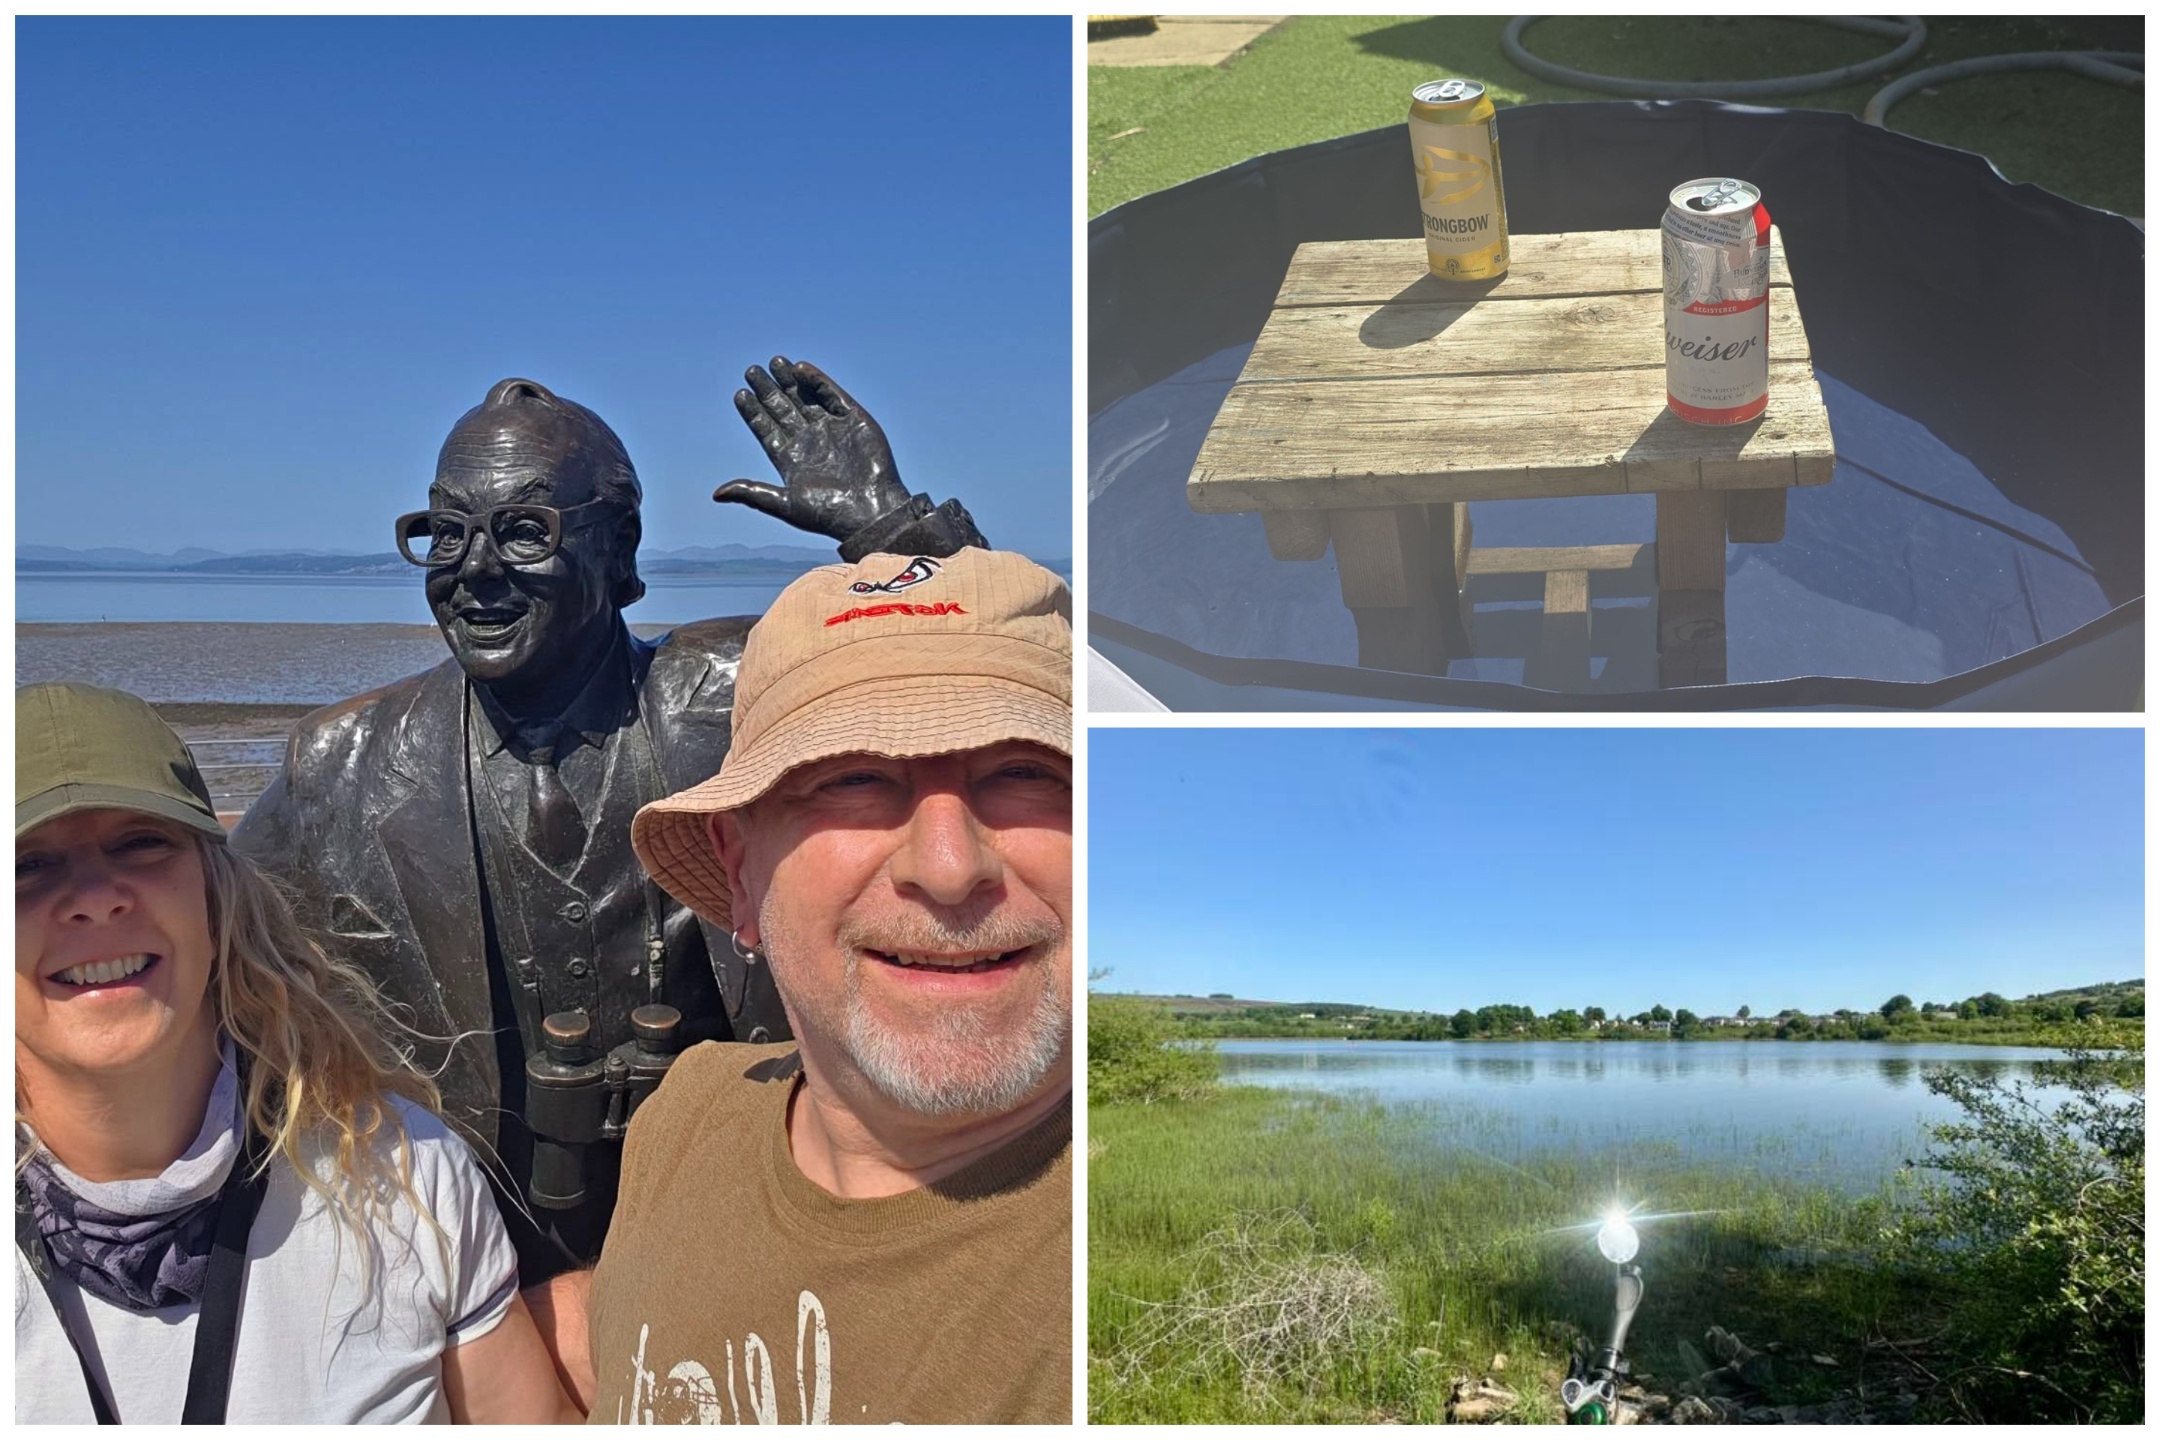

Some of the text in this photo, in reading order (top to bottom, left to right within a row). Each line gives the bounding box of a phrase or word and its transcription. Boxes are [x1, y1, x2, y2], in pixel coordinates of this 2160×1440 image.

[1421, 212, 1489, 234] TRONGBOW
[1693, 306, 1737, 314] REGISTERED
[1665, 322, 1757, 362] weiser
[1700, 394, 1734, 402] BARLEY
